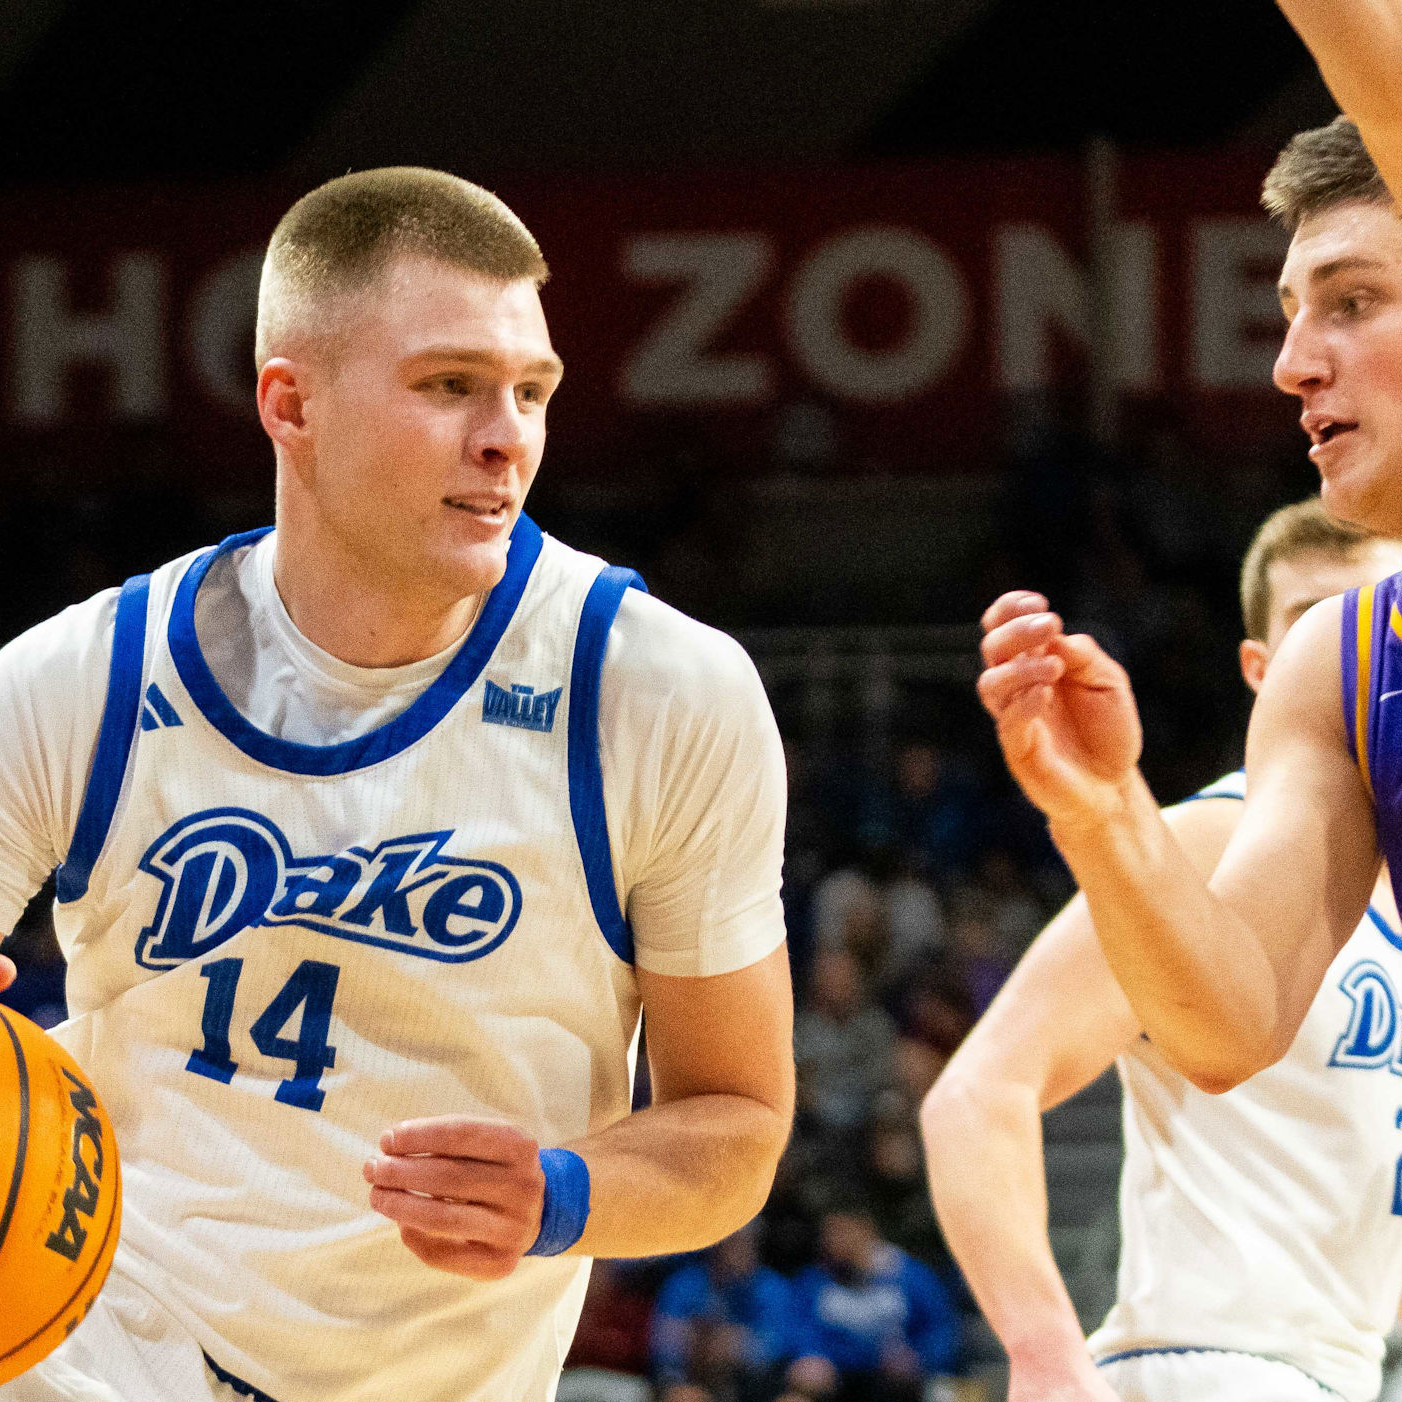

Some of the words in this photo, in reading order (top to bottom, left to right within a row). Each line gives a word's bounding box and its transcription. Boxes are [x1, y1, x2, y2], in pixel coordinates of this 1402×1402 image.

[615, 218, 1288, 408] ZONE
[134, 805, 523, 971] Dake
[185, 957, 340, 1112] 14
[45, 1066, 104, 1263] NCAA
